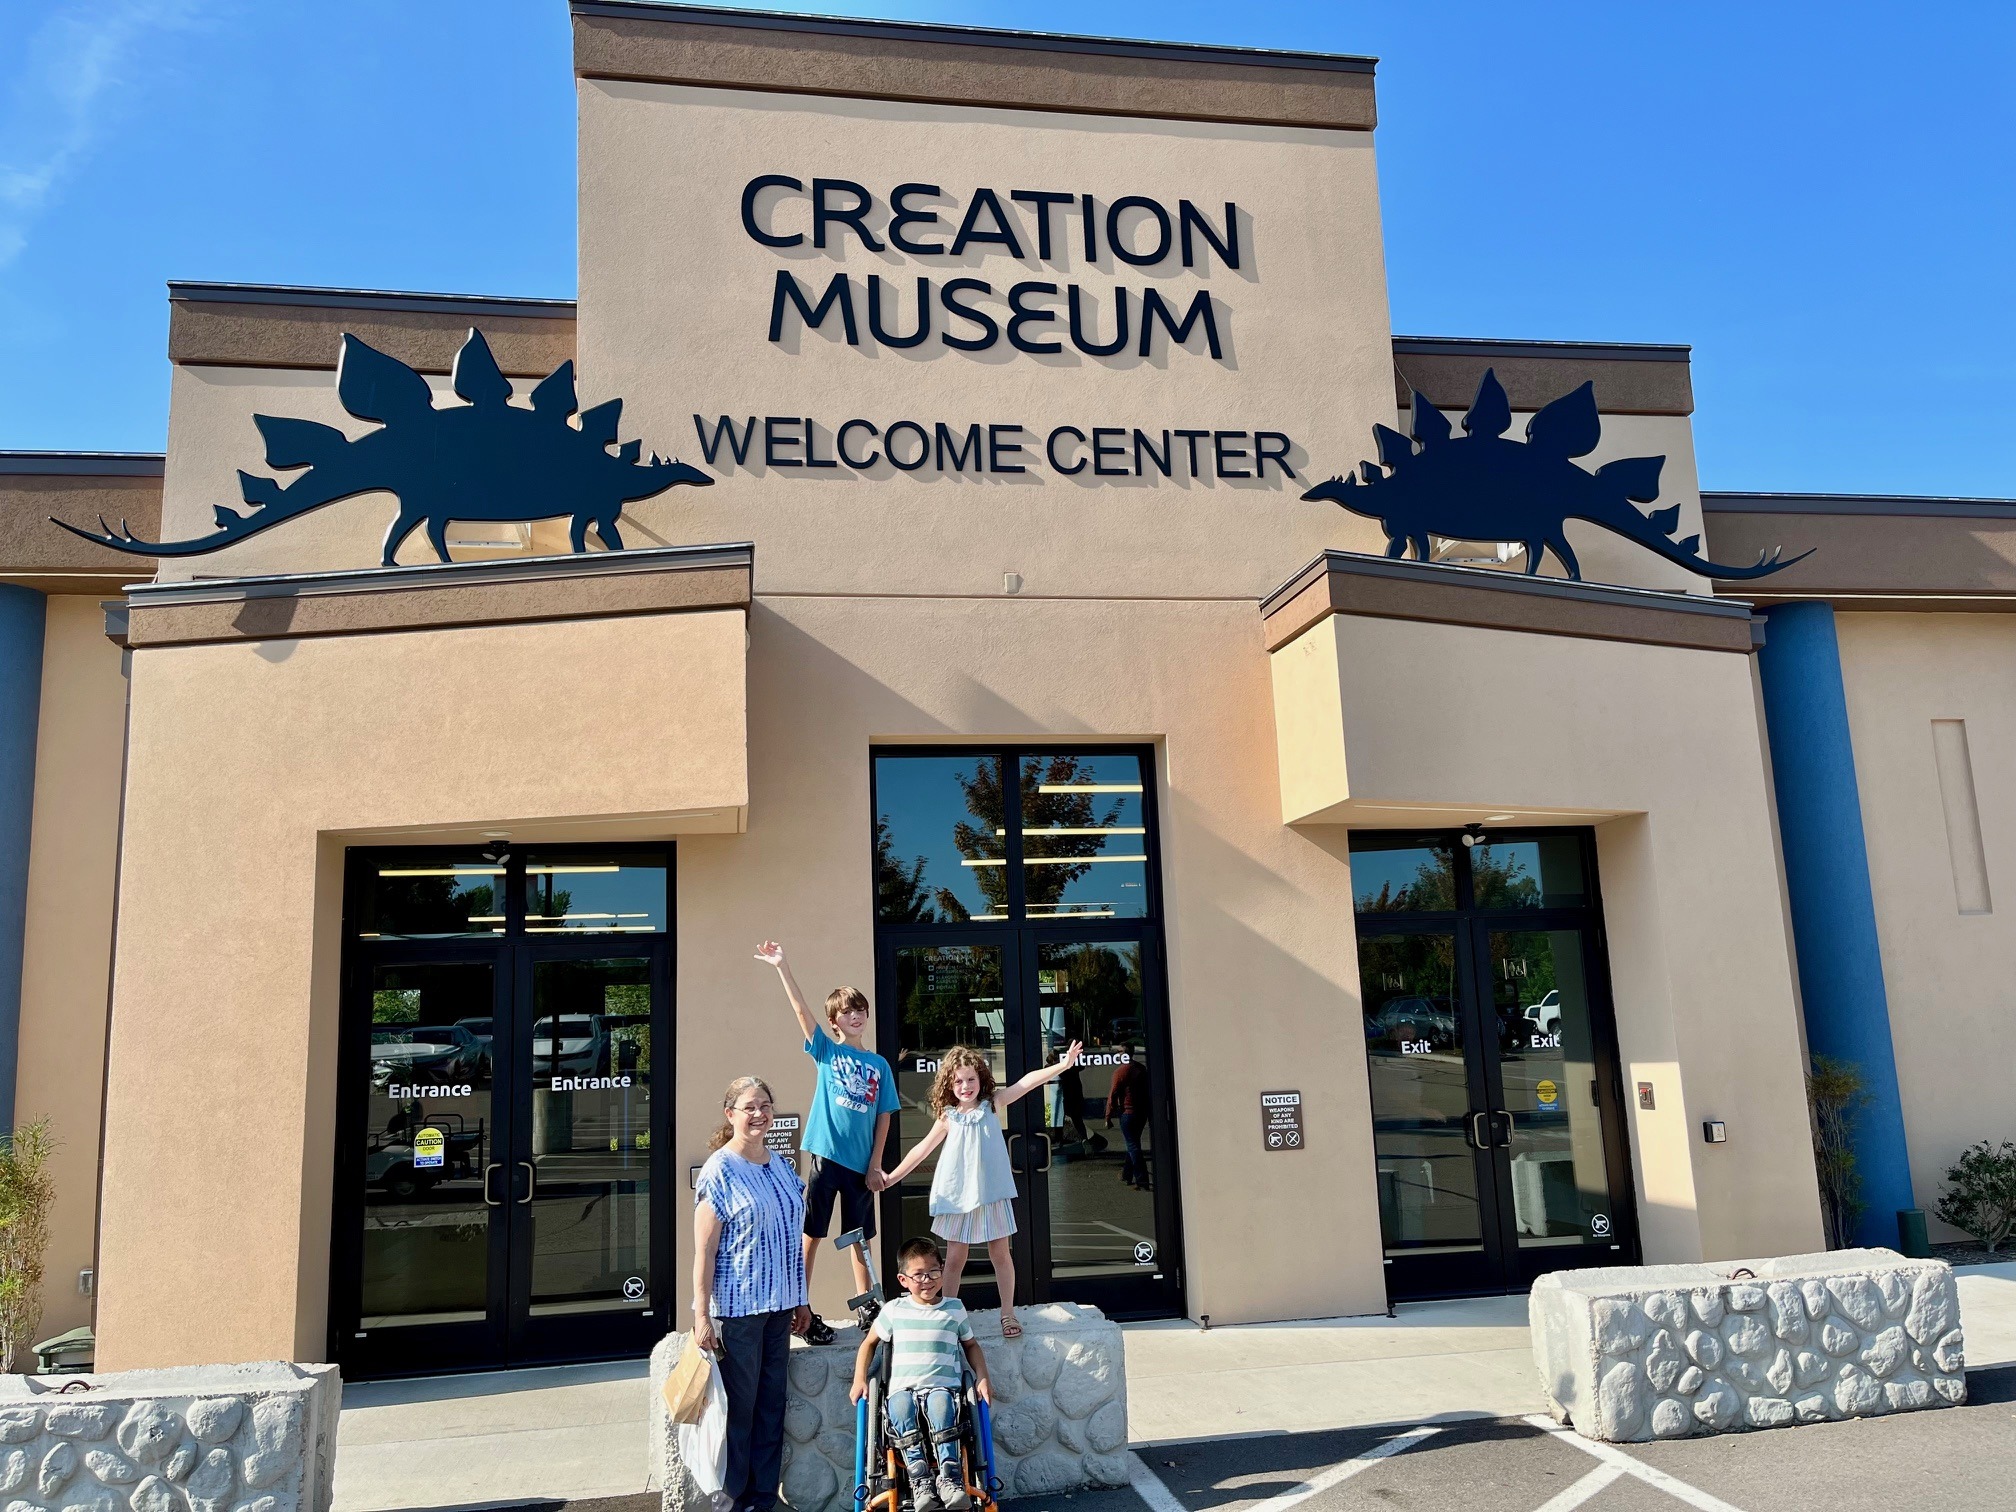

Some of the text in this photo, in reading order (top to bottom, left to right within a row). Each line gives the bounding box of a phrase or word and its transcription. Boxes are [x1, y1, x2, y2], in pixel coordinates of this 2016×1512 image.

[740, 174, 1240, 269] CREATION
[768, 270, 1223, 360] MUSEUM
[692, 414, 1297, 479] WELCOME CENTER
[1401, 1039, 1432, 1055] Exit
[1530, 1033, 1561, 1048] Exit
[1059, 1053, 1131, 1067] Etrance
[388, 1083, 472, 1099] Entrance
[550, 1075, 632, 1092] Entrance
